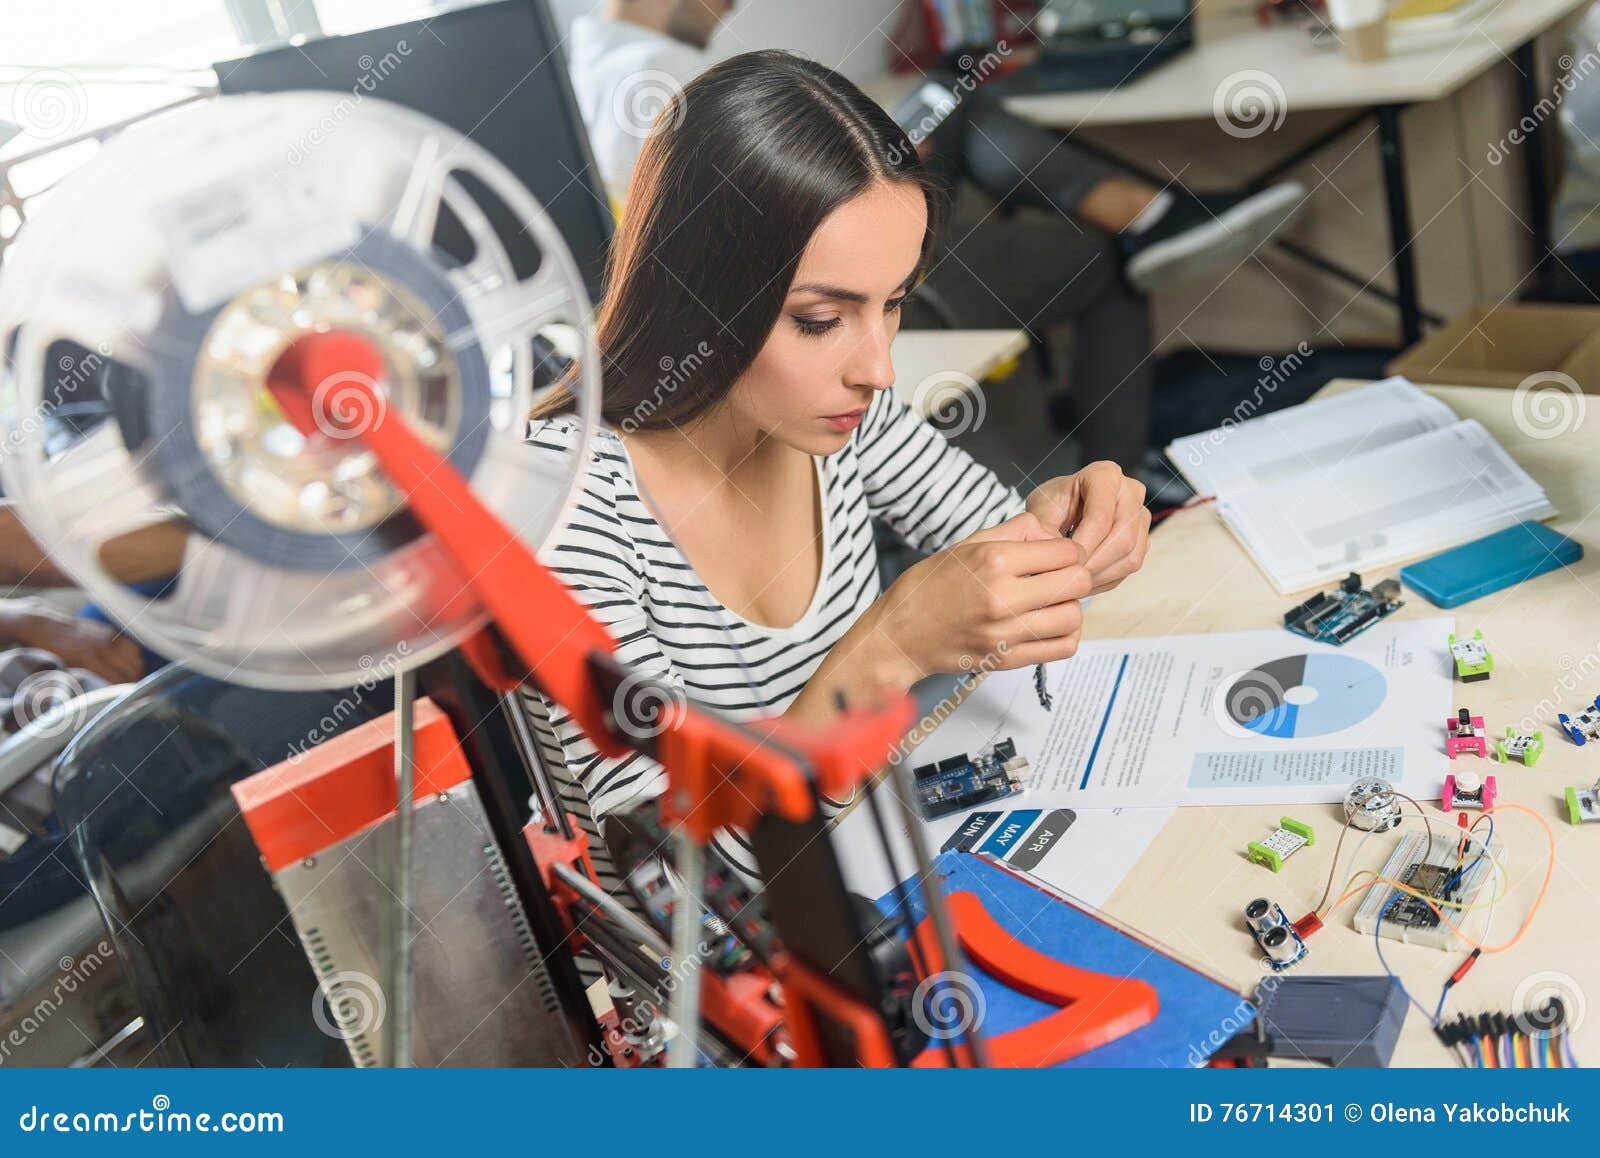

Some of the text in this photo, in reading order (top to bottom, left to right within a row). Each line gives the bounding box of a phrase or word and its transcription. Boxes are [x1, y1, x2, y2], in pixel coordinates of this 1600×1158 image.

[962, 816, 986, 837] JUN
[996, 823, 1021, 846] MAY
[1028, 829, 1054, 852] APR
